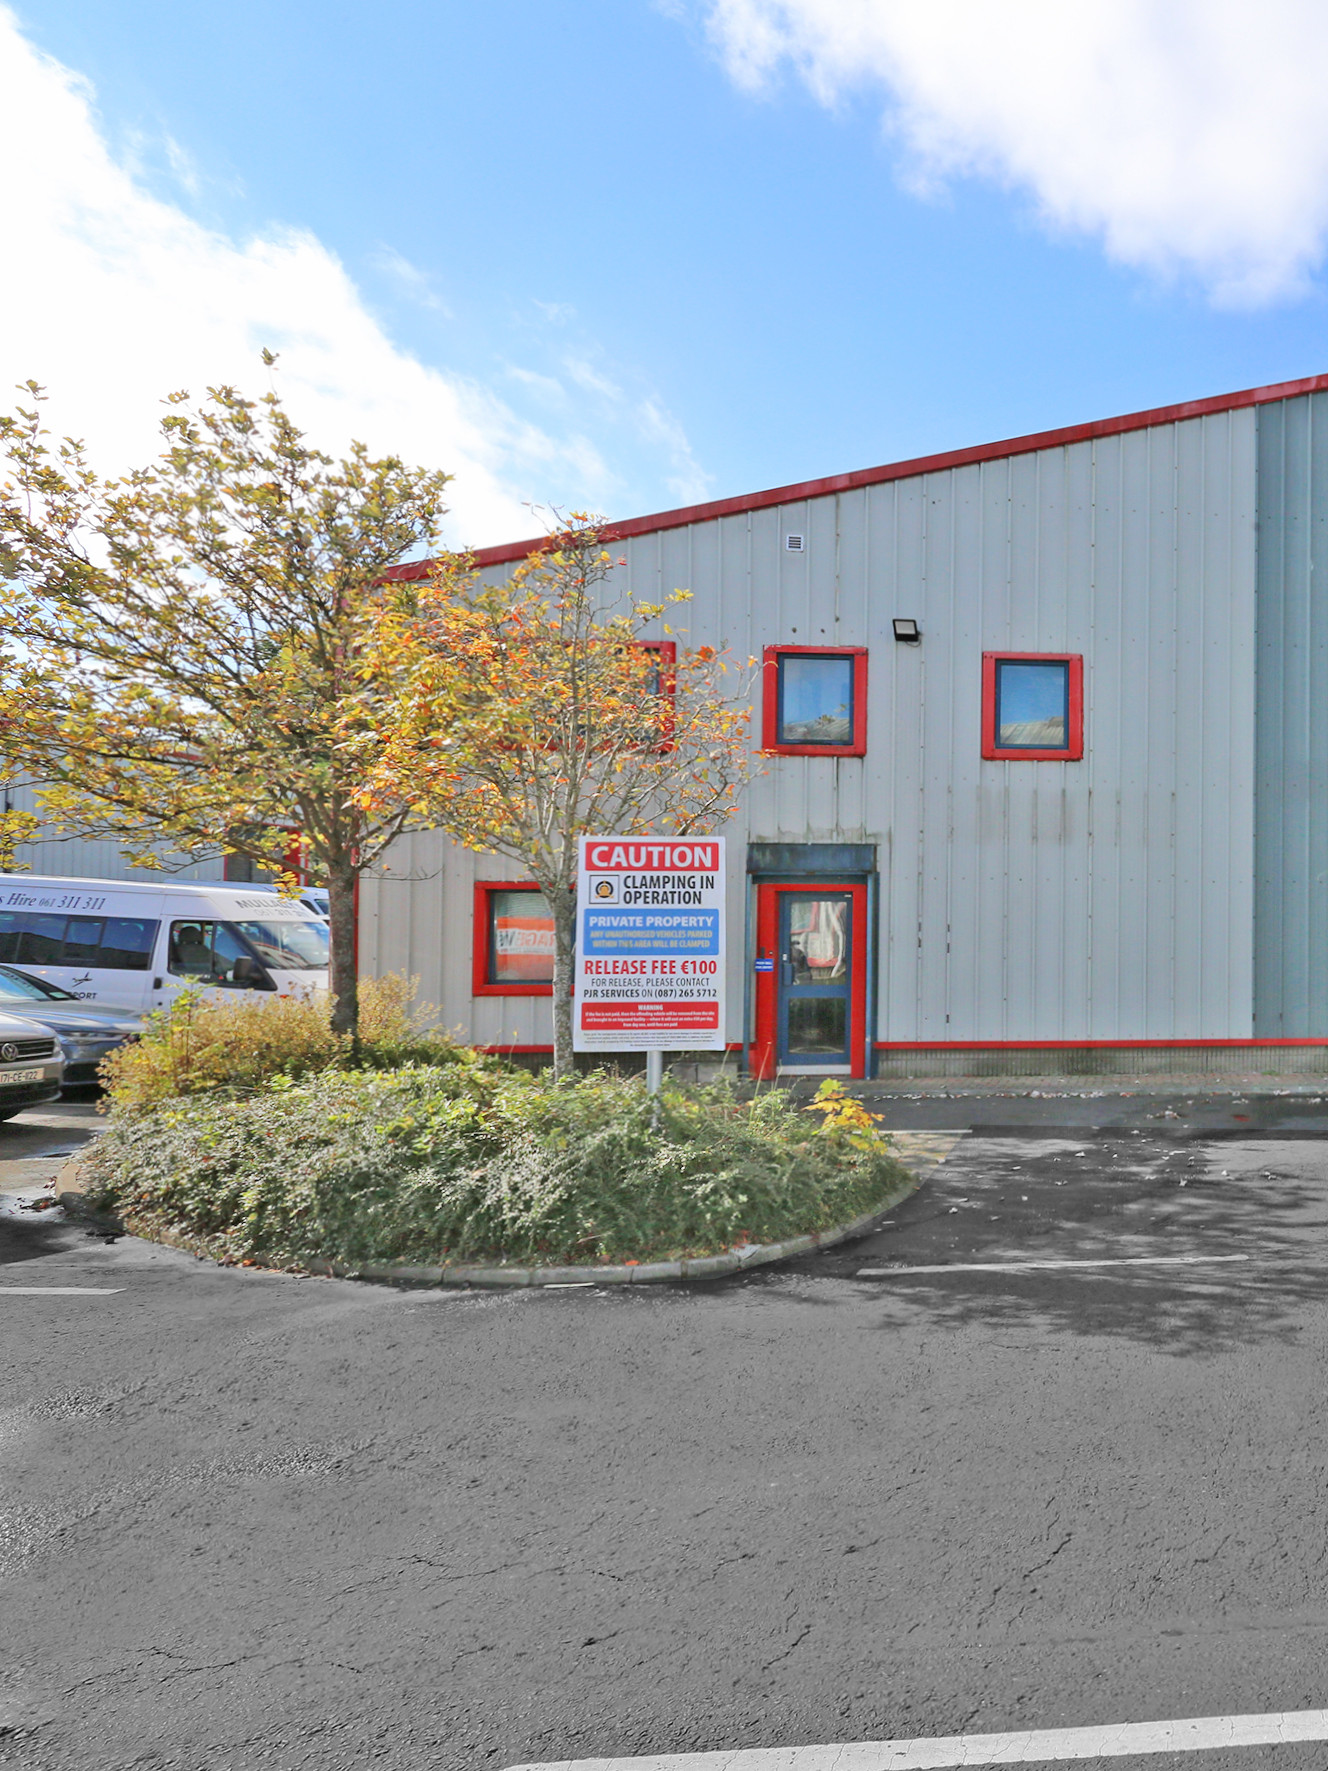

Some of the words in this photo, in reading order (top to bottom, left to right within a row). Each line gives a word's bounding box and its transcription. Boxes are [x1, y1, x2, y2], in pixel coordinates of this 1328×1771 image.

[591, 845, 712, 867] CAUTION
[623, 875, 696, 889] CLAMPING
[700, 875, 715, 889] IN
[7, 893, 37, 906] Hire
[38, 897, 56, 907] 061
[57, 895, 82, 909] 311
[82, 897, 106, 910] 311
[623, 891, 702, 904] OPERATION
[589, 916, 643, 927] PRIVATE
[646, 916, 714, 927] PROPERTY
[590, 930, 603, 938] ANY
[605, 930, 655, 938] UNAUTHORISED
[657, 930, 686, 938] VEHICLES
[687, 930, 713, 938] PARKED
[592, 940, 617, 948] WITHIN
[618, 940, 633, 948] THIS
[635, 940, 651, 948] AREA
[652, 940, 669, 948] WILL
[670, 940, 679, 948] BE
[680, 939, 711, 947] CLAMPED
[584, 960, 647, 974] RELEASE
[651, 960, 676, 974] FEE
[681, 960, 717, 974] €100
[591, 978, 607, 987] FOR
[608, 978, 644, 988] RELEASE,
[646, 978, 674, 987] PLEASE
[676, 977, 710, 987] CONTACT
[583, 989, 598, 998] PJR
[600, 989, 640, 998] SERVICES
[641, 989, 653, 998] ON
[654, 989, 677, 999] (087)
[678, 989, 694, 998] 265
[697, 989, 717, 998] 5712
